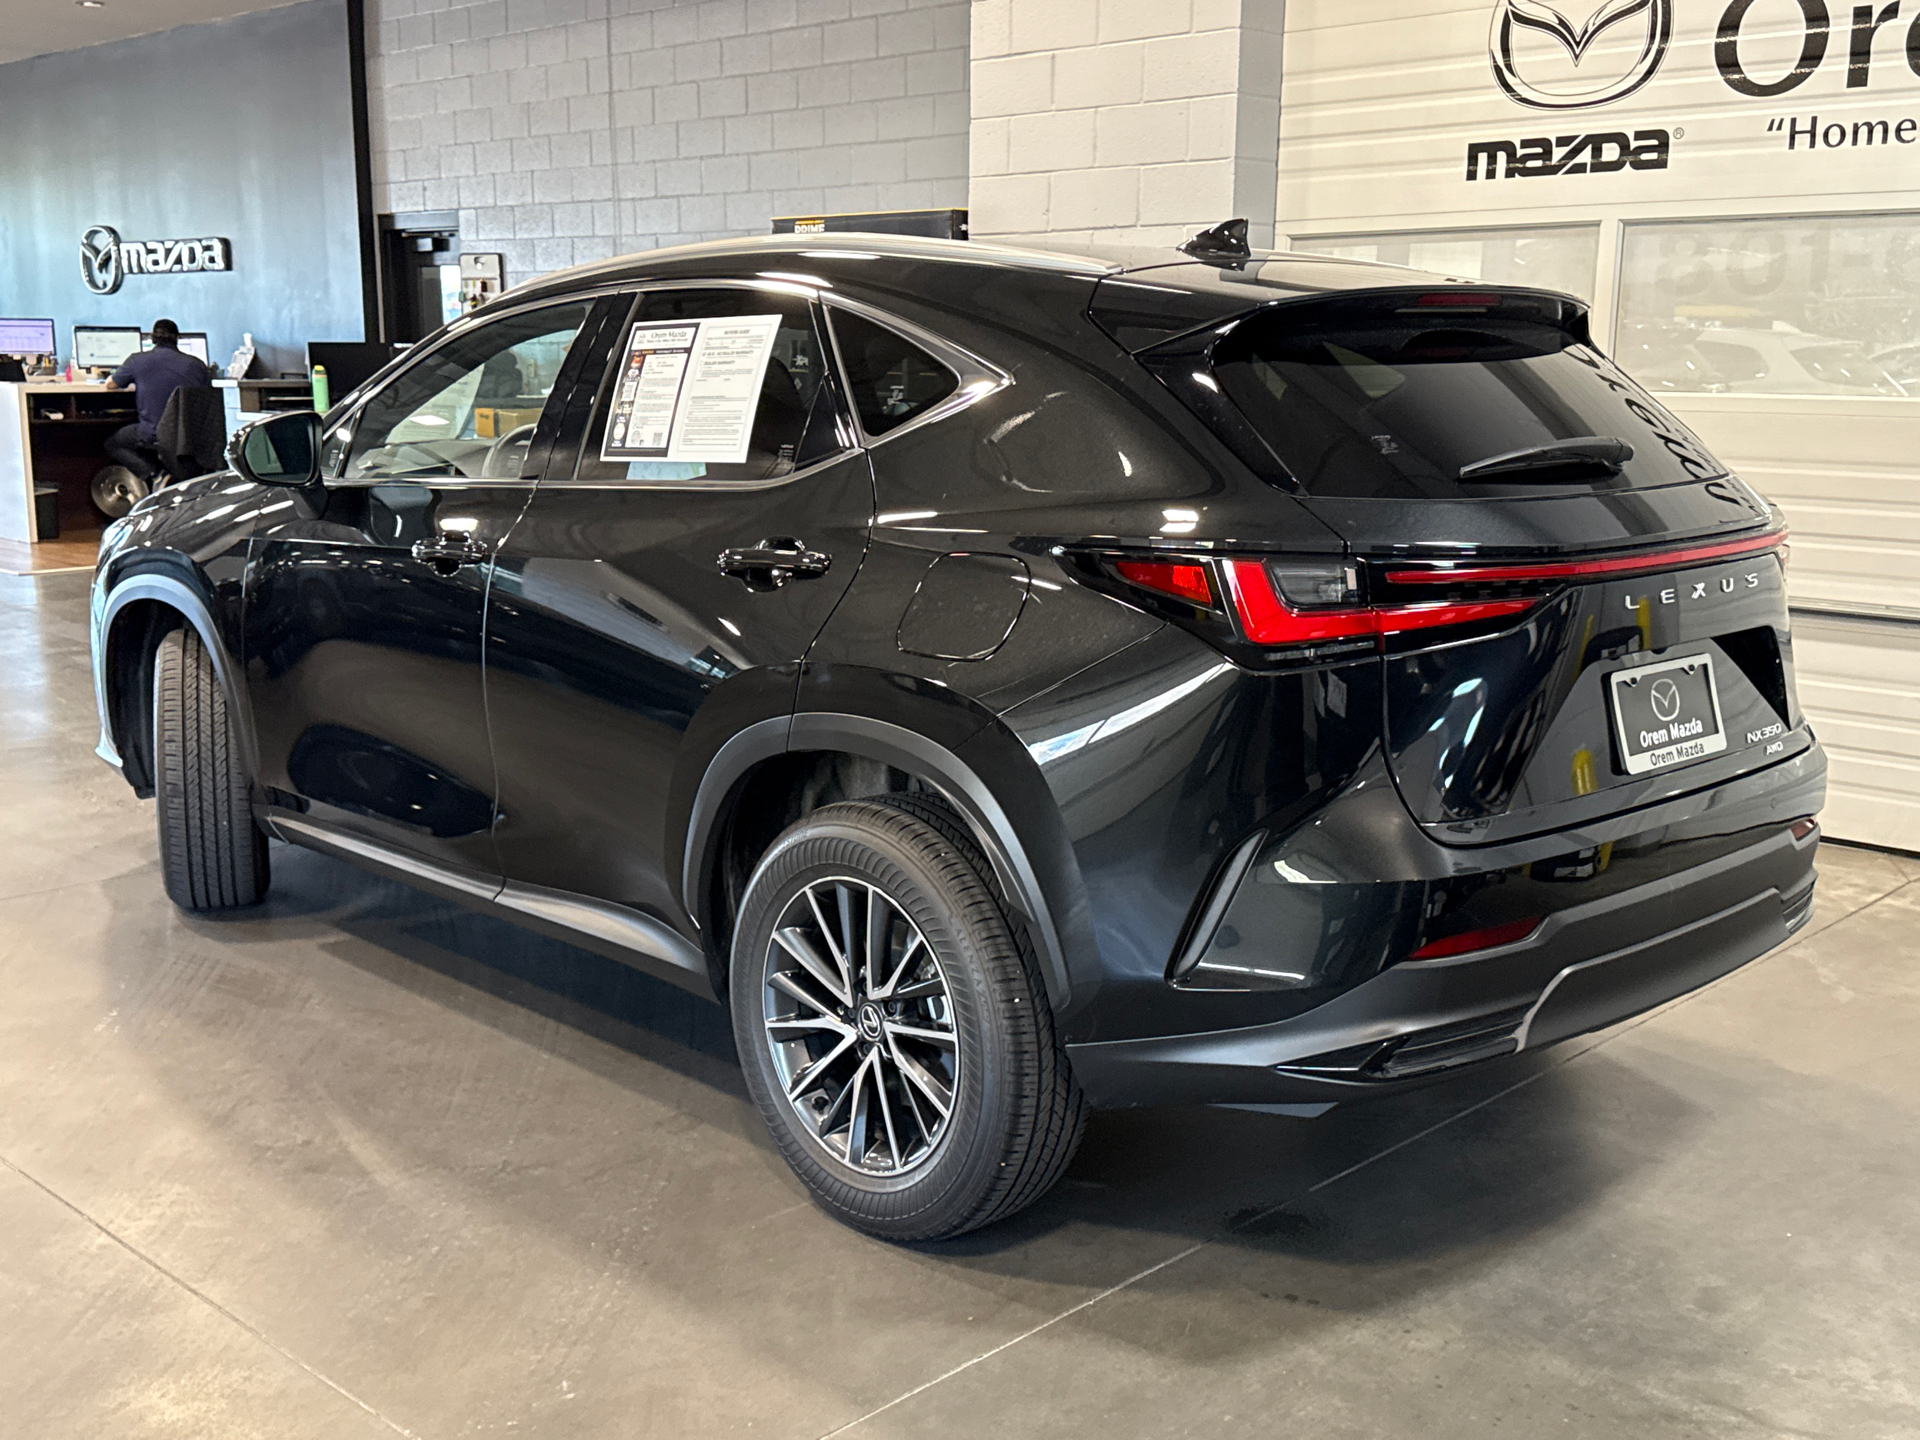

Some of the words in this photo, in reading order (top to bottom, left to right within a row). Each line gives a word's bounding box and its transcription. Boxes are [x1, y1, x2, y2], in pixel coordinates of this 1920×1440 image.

[1714, 0, 1920, 97] Or
[1465, 128, 1670, 182] mazda
[119, 236, 231, 275] mazda
[1625, 573, 1758, 609] LEXUS
[1639, 727, 1670, 748] Orem
[1670, 717, 1703, 739] Mazda
[1745, 723, 1782, 744] NX350
[1766, 741, 1784, 756] AWD
[1650, 749, 1675, 767] Orem
[1677, 741, 1705, 760] Mazda
